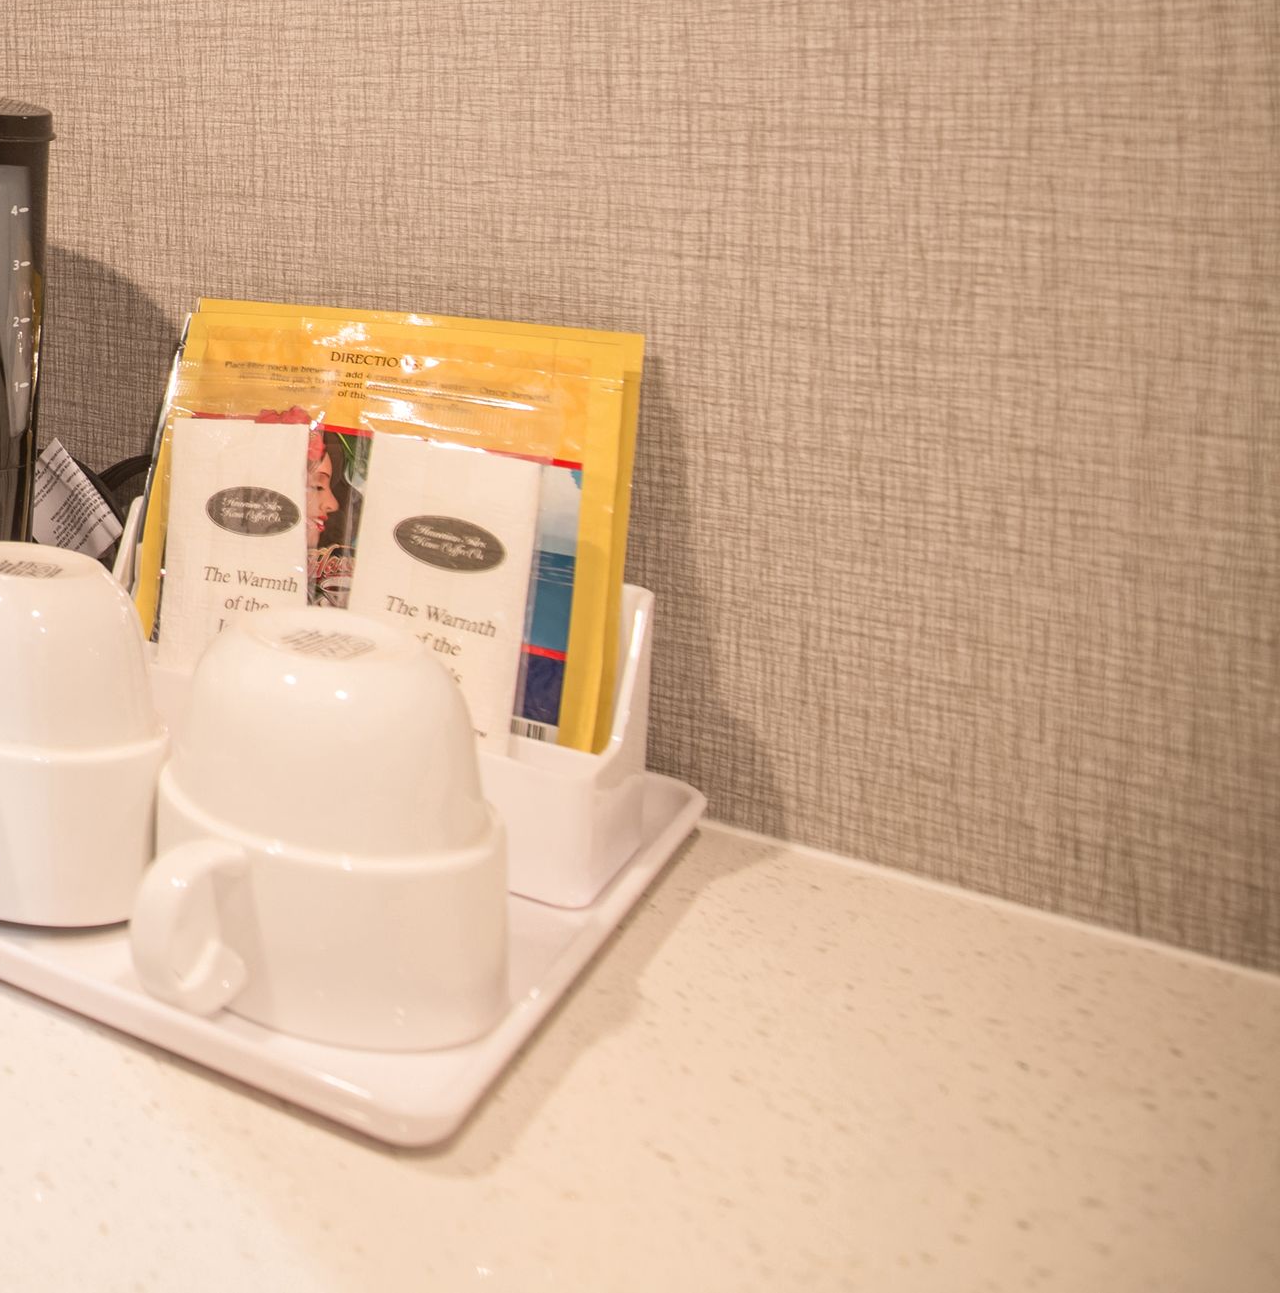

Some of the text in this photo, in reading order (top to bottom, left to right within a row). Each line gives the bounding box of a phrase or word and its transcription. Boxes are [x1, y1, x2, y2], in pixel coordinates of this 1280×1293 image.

[11, 205, 18, 216] 4
[12, 260, 20, 271] 3
[12, 317, 19, 328] 2
[345, 372, 364, 380] add
[14, 382, 19, 393] 1
[338, 388, 347, 397] of
[204, 565, 298, 593] The Warmth
[224, 595, 244, 610] of
[386, 595, 497, 638] The Warmth
[433, 636, 463, 657] the
